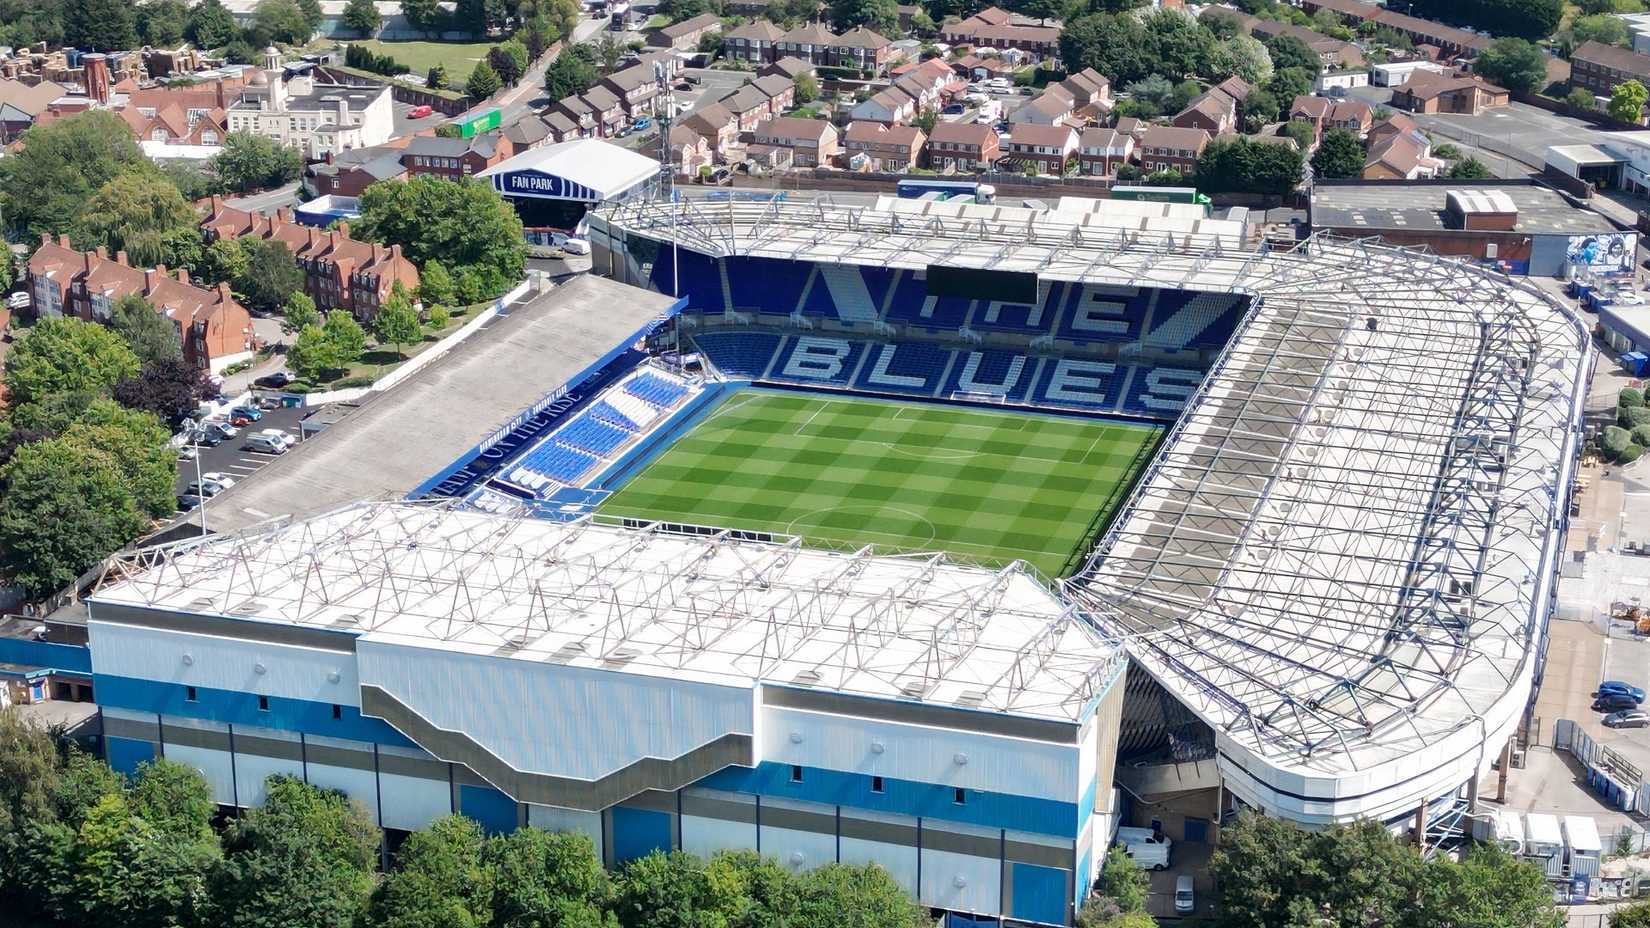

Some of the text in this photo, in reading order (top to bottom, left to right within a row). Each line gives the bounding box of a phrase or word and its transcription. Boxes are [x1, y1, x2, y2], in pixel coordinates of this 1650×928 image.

[512, 176, 553, 191] FAN PARK
[782, 336, 1204, 410] BLUES
[512, 416, 549, 439] THE
[540, 393, 583, 417] RISE
